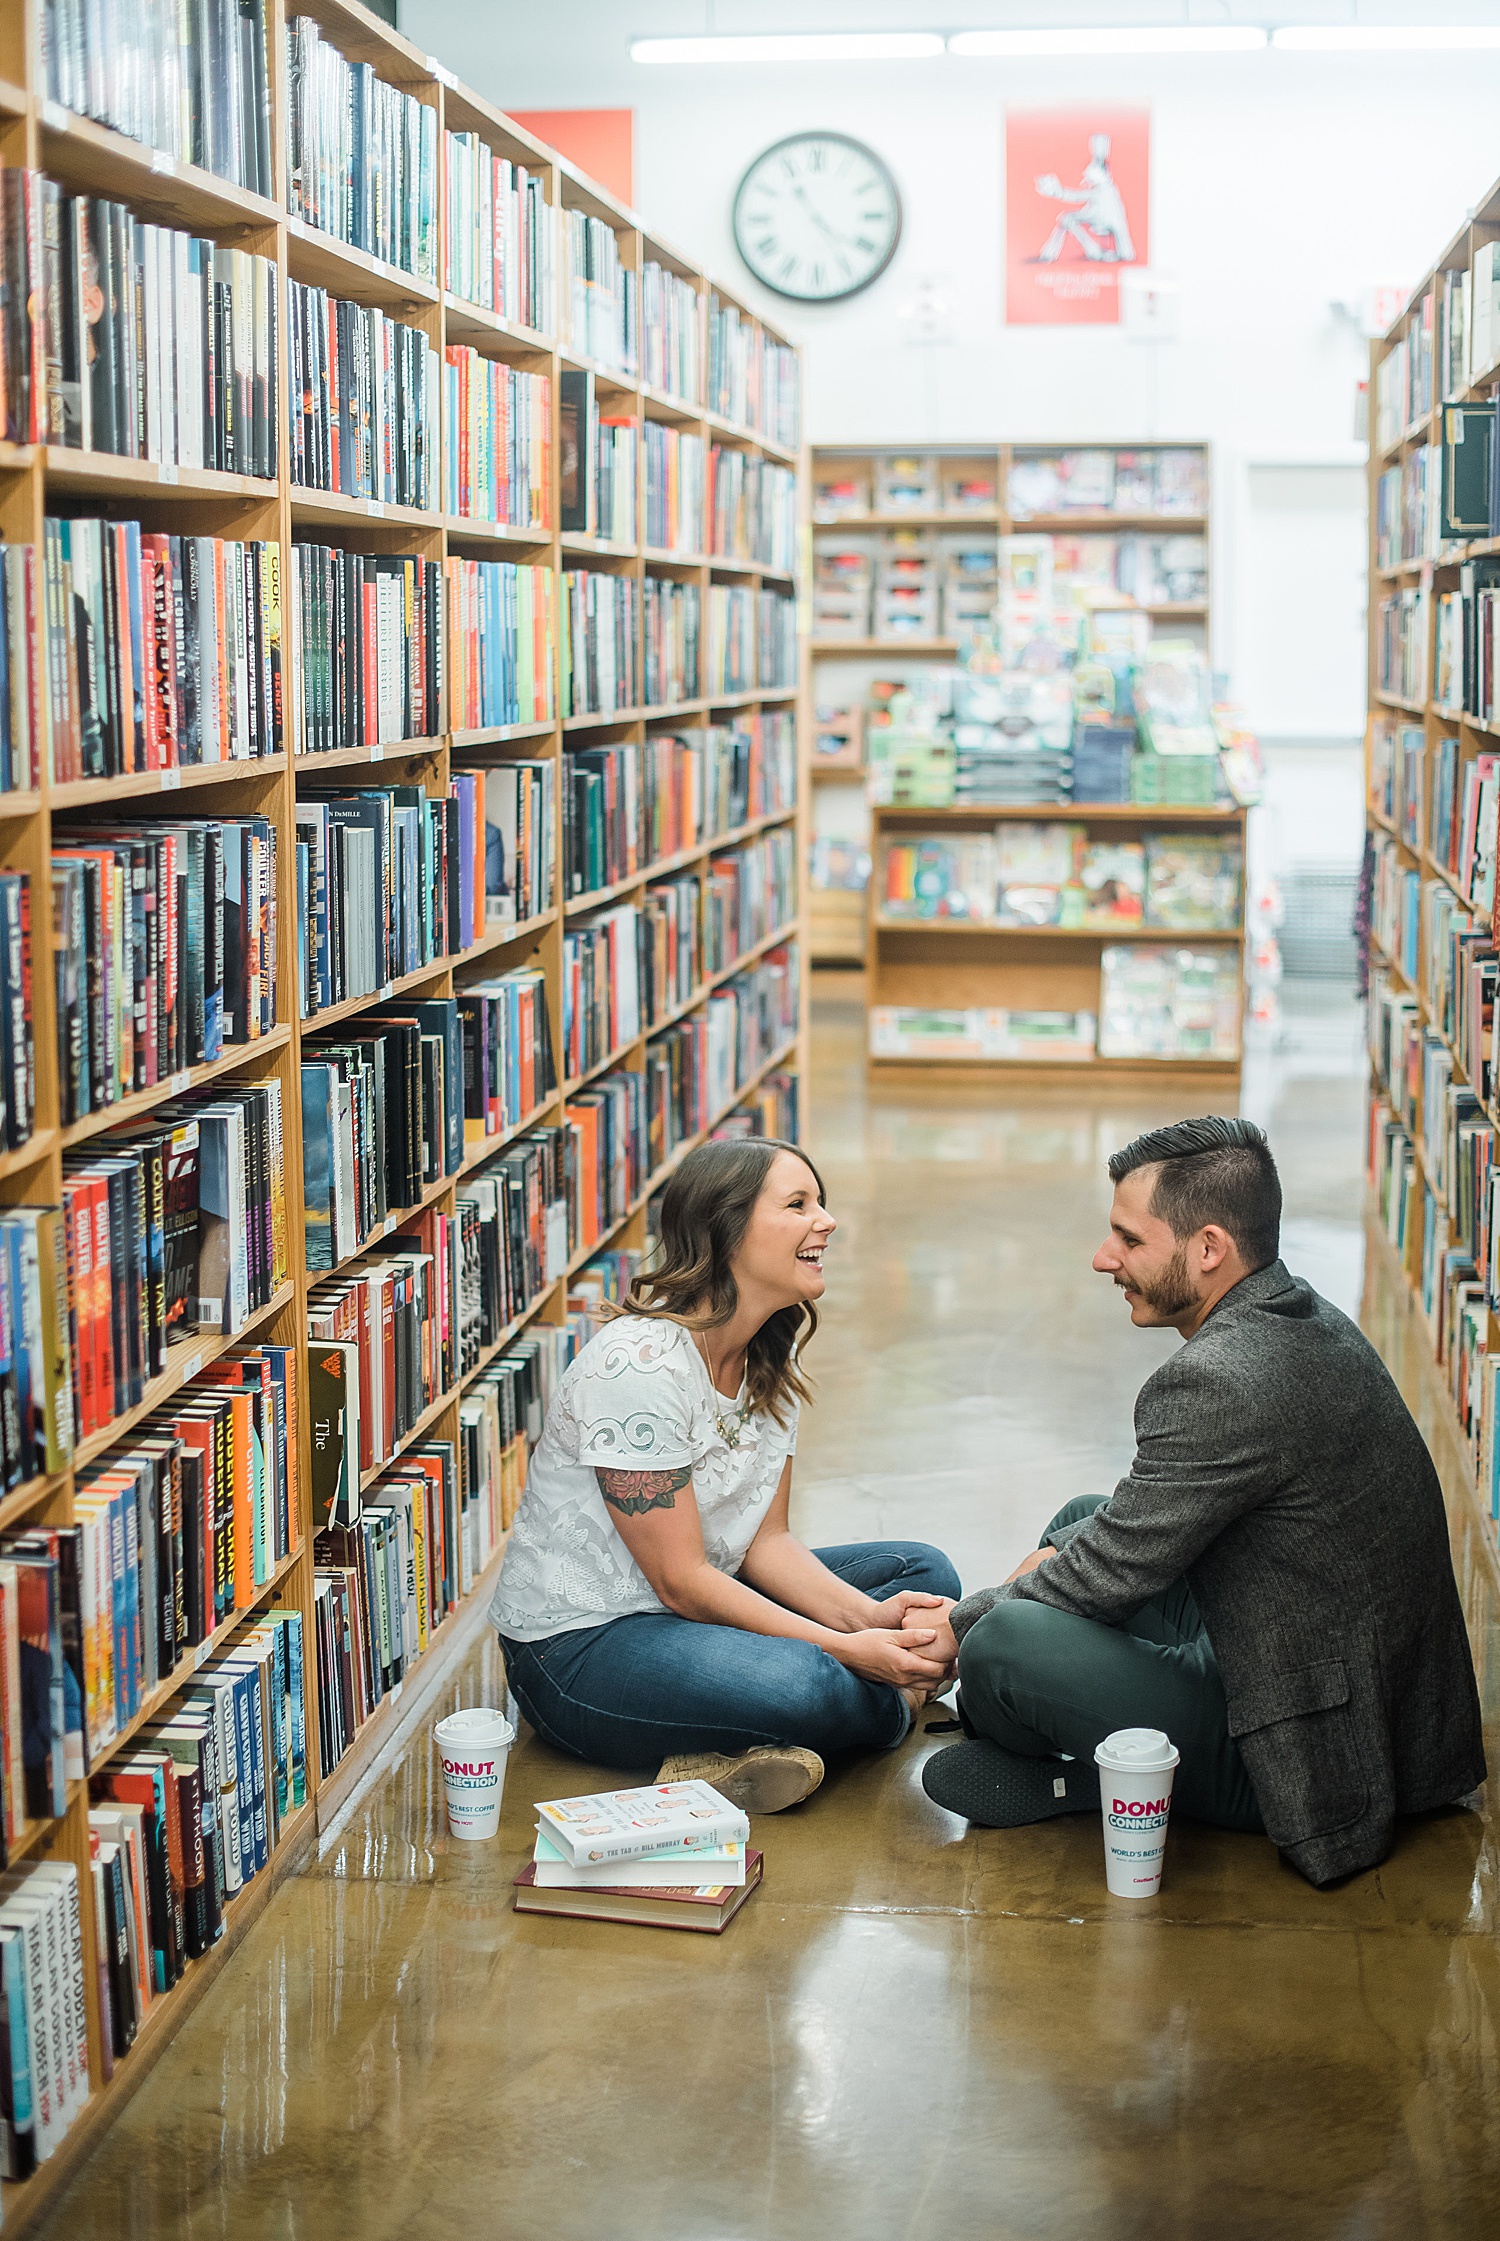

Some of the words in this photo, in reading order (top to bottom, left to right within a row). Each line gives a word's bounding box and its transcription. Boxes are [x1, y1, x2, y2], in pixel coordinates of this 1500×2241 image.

[175, 597, 185, 678] CONNOLLY
[215, 838, 224, 903] PATRICIA
[216, 906, 224, 984] CORNWELL
[260, 969, 268, 998] FIRE
[152, 1158, 162, 1232] COULTER
[175, 1210, 198, 1227] ELLISON
[77, 1209, 89, 1274] COULTER
[97, 1202, 108, 1266] COULTER
[226, 1413, 234, 1498] ROBERT
[315, 1419, 330, 1450] The
[127, 1505, 136, 1569] COULTER
[163, 1475, 171, 1534] COULTER
[113, 1515, 123, 1580] COULTER
[227, 1521, 235, 1585] CRAIS
[164, 1595, 172, 1641] SECOND
[225, 1694, 234, 1778] CUSSLER
[192, 1788, 203, 1878] TYPHOON
[474, 1804, 495, 1812] COFFEE
[1113, 1795, 1172, 1816] DONU
[241, 1822, 250, 1855] WIND
[641, 1843, 655, 1851] BILL
[657, 1839, 681, 1849] MURRAY
[1111, 1847, 1141, 1857] WORLD'S
[1143, 1848, 1158, 1857] BEST
[68, 1878, 81, 1965] HARLAN
[28, 1924, 43, 2012] HARLAN
[46, 1908, 58, 1996] HARLAN
[52, 2000, 63, 2072] COBEN
[74, 1970, 85, 2039] COBEN
[35, 2017, 48, 2091] COBEN
